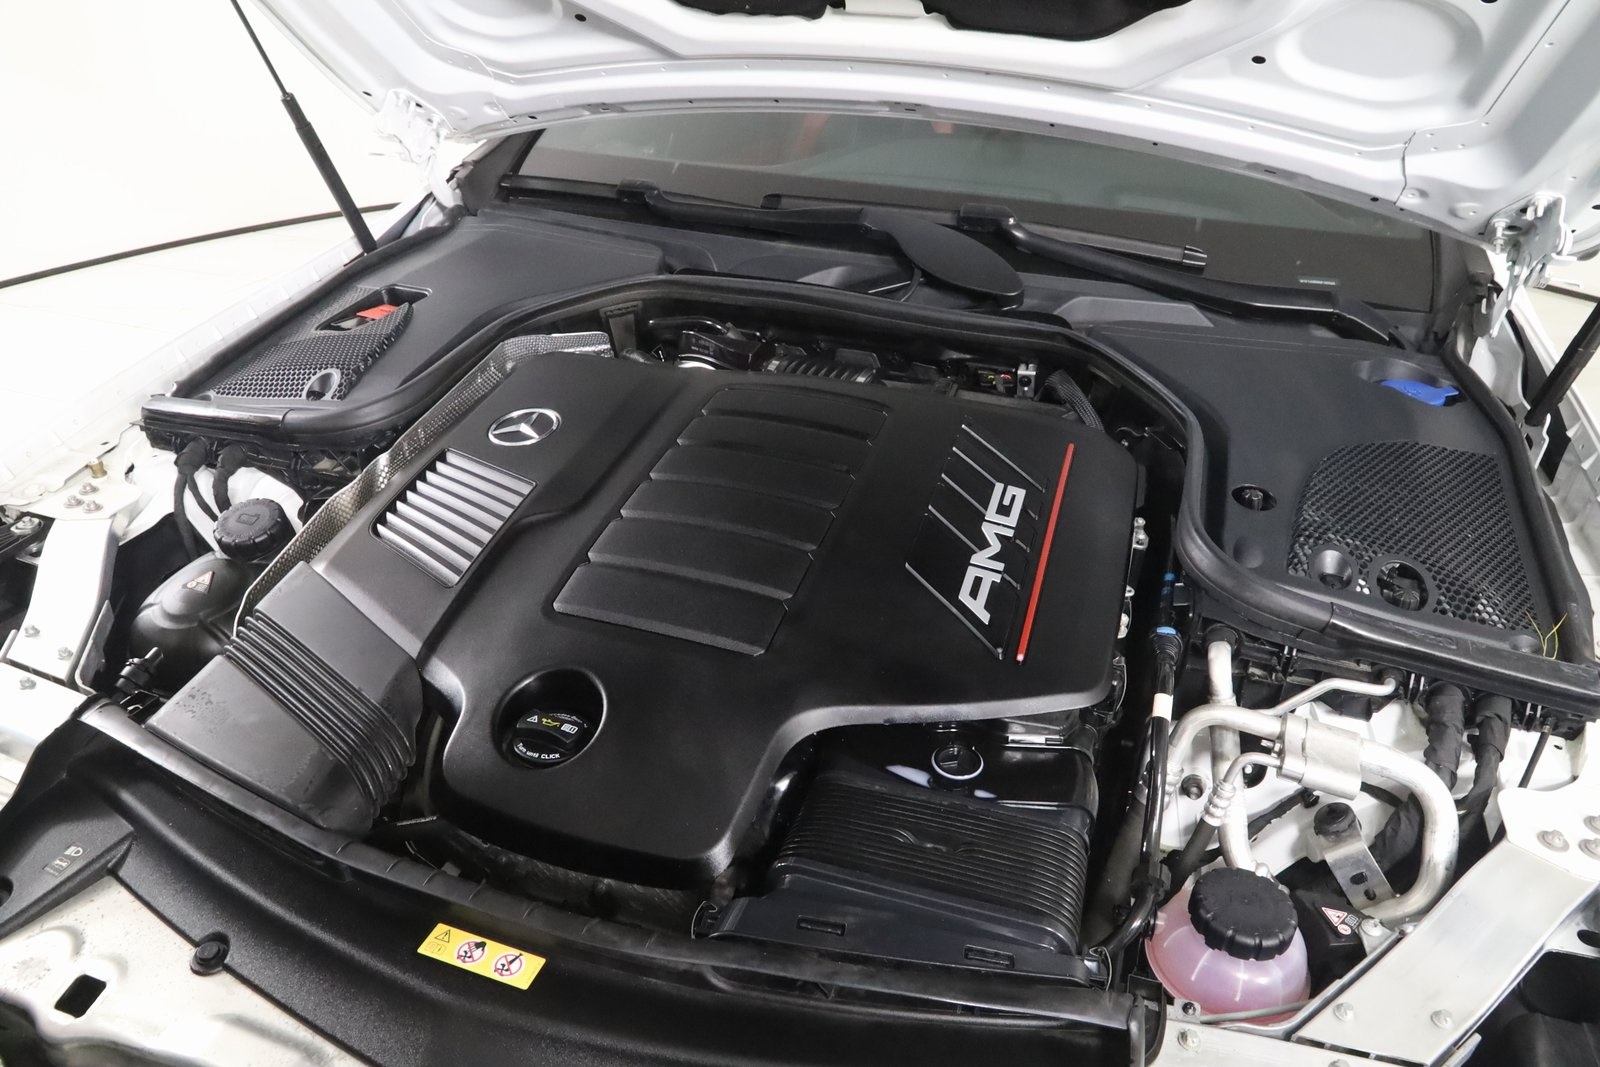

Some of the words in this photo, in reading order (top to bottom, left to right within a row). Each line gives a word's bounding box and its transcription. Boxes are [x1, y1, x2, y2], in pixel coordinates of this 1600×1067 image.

[958, 482, 1026, 625] AMG
[516, 742, 527, 753] Turn
[526, 750, 540, 758] until
